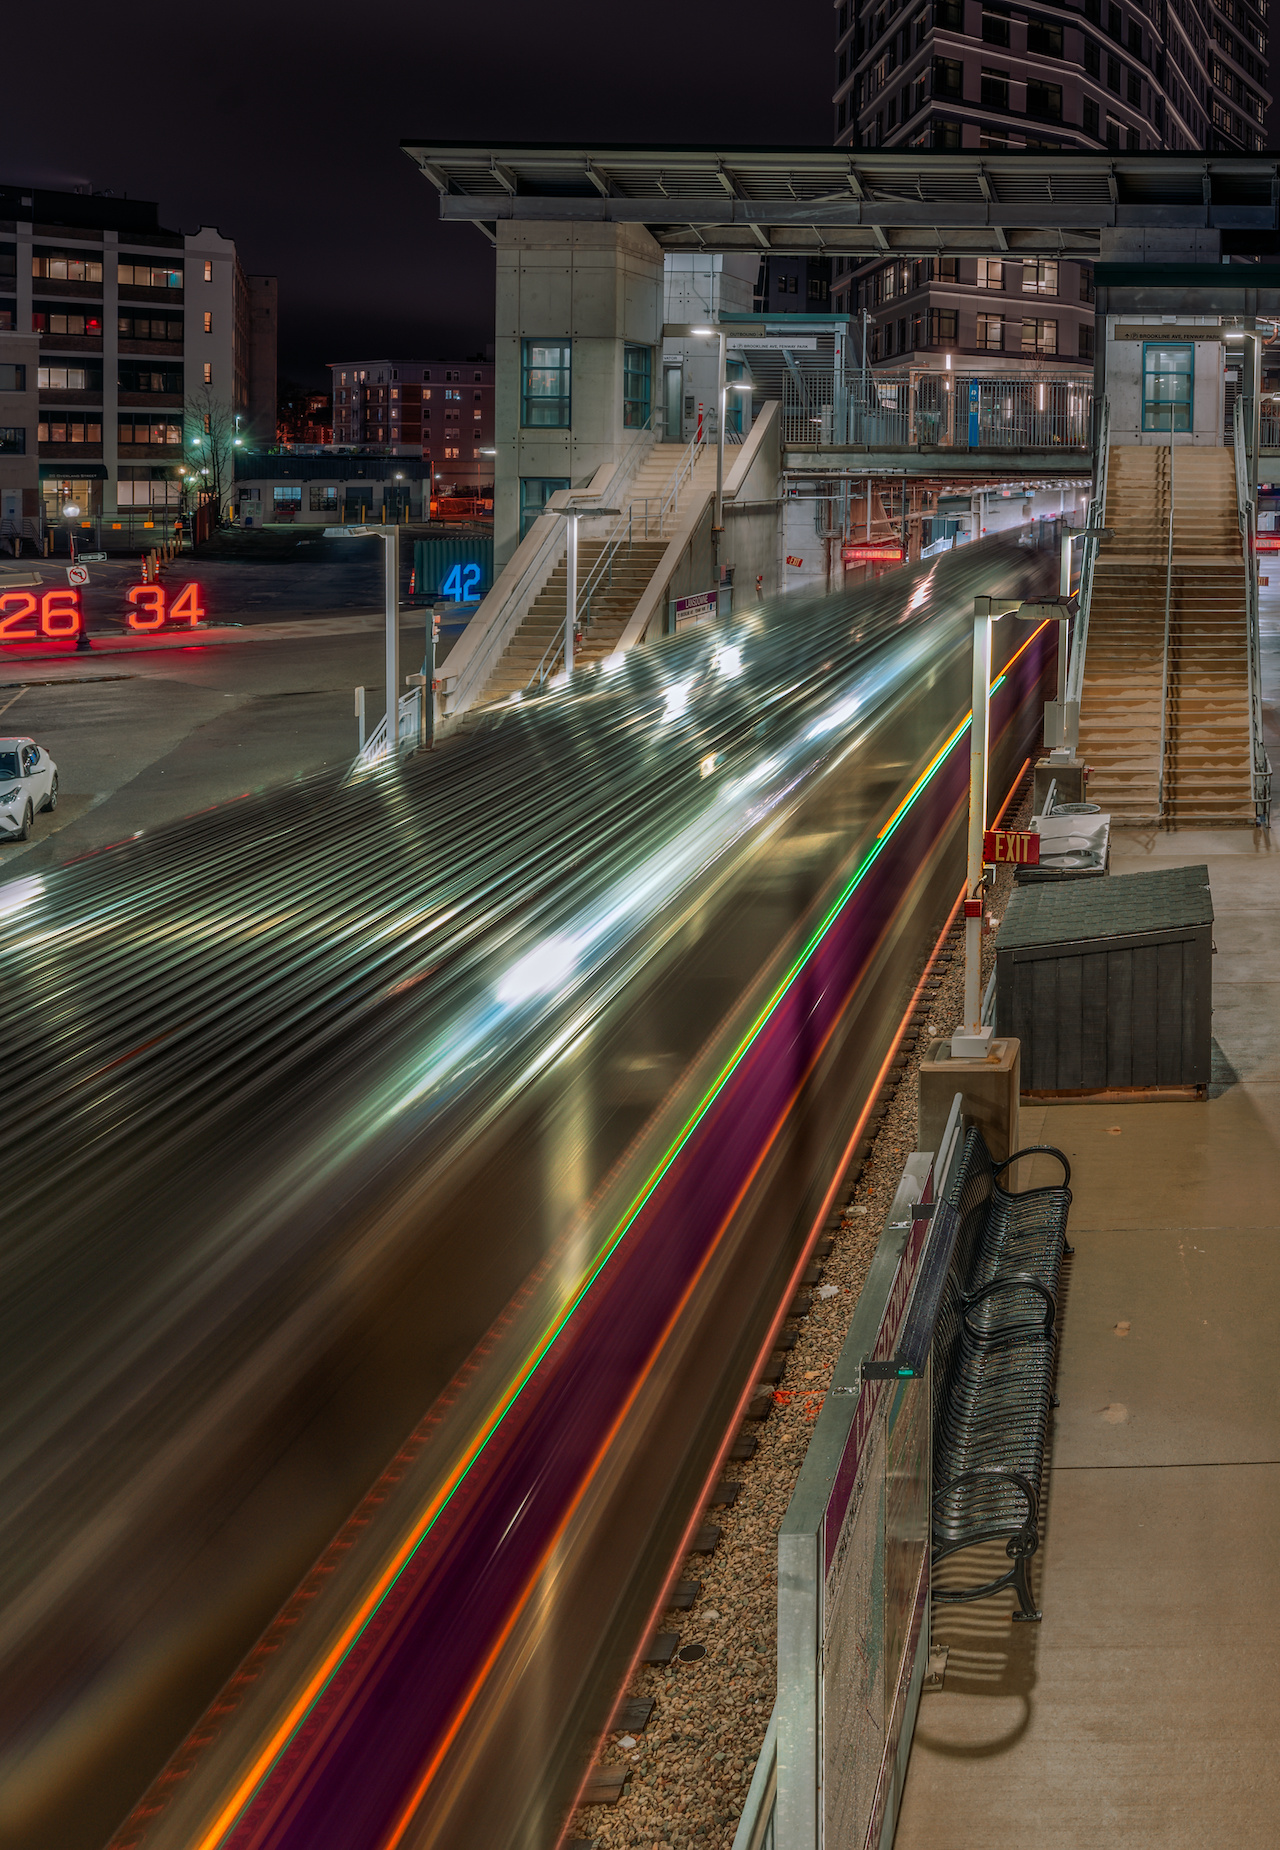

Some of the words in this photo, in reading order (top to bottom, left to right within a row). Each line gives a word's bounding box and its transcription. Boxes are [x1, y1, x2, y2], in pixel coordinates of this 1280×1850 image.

[789, 556, 801, 567] EXIT
[442, 563, 481, 603] 42
[0, 590, 82, 640] 26
[126, 582, 205, 629] 34
[995, 834, 1031, 863] EXIT
